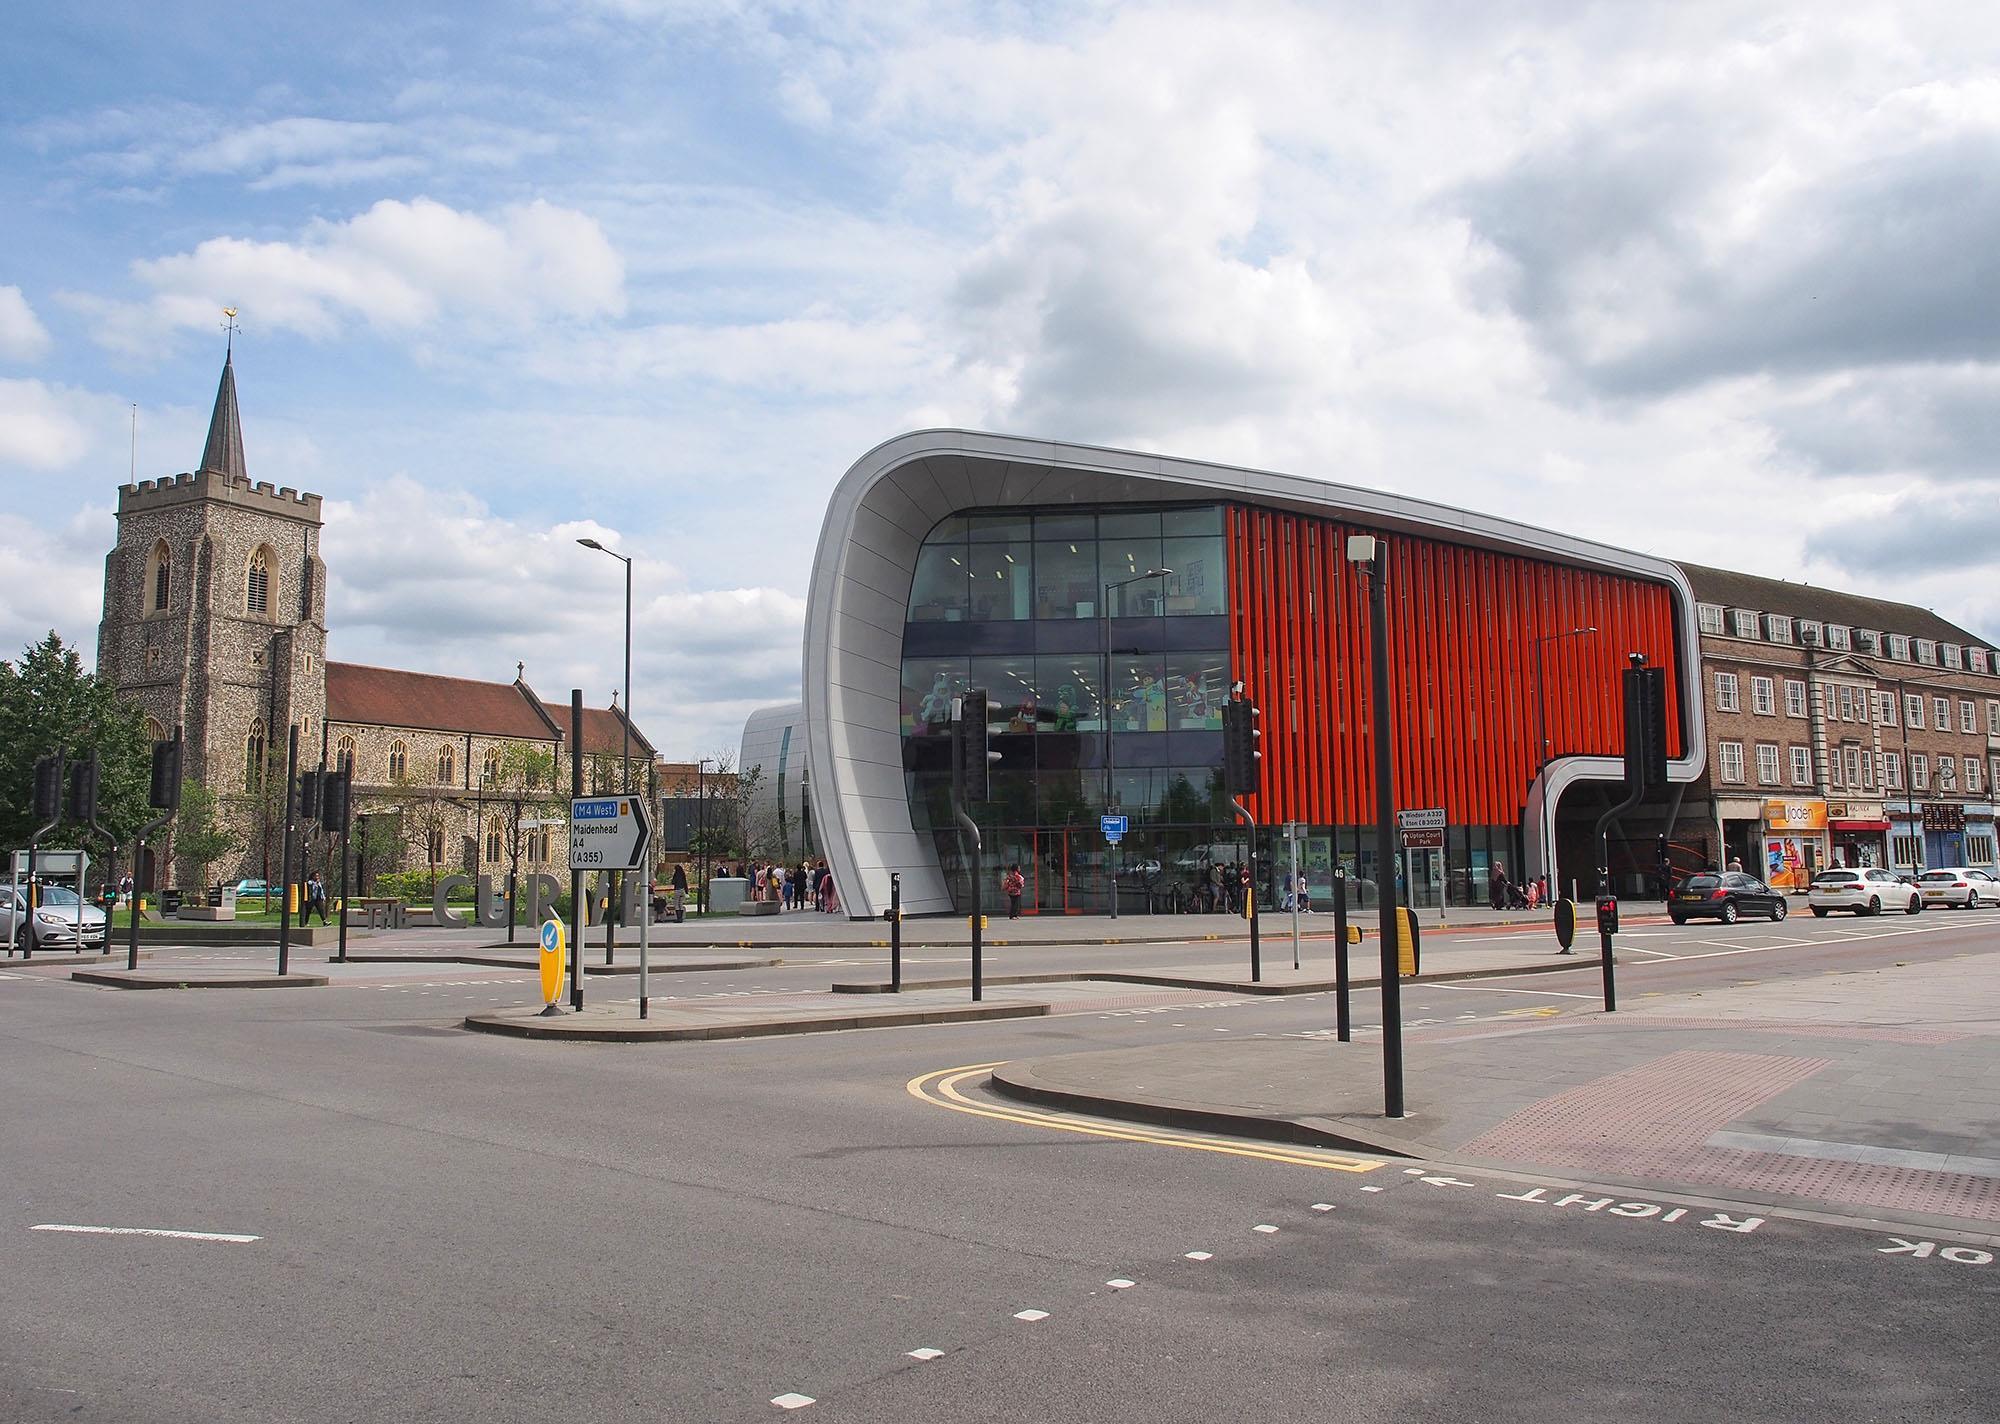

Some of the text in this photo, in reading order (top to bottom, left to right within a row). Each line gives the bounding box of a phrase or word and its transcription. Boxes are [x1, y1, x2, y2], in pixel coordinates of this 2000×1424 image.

[574, 802, 617, 817] (M4 West)
[573, 823, 618, 835] Maidenhead
[572, 838, 585, 848] A4
[572, 850, 604, 864] (A355)
[1495, 1188, 1994, 1265] OK RIGHT
